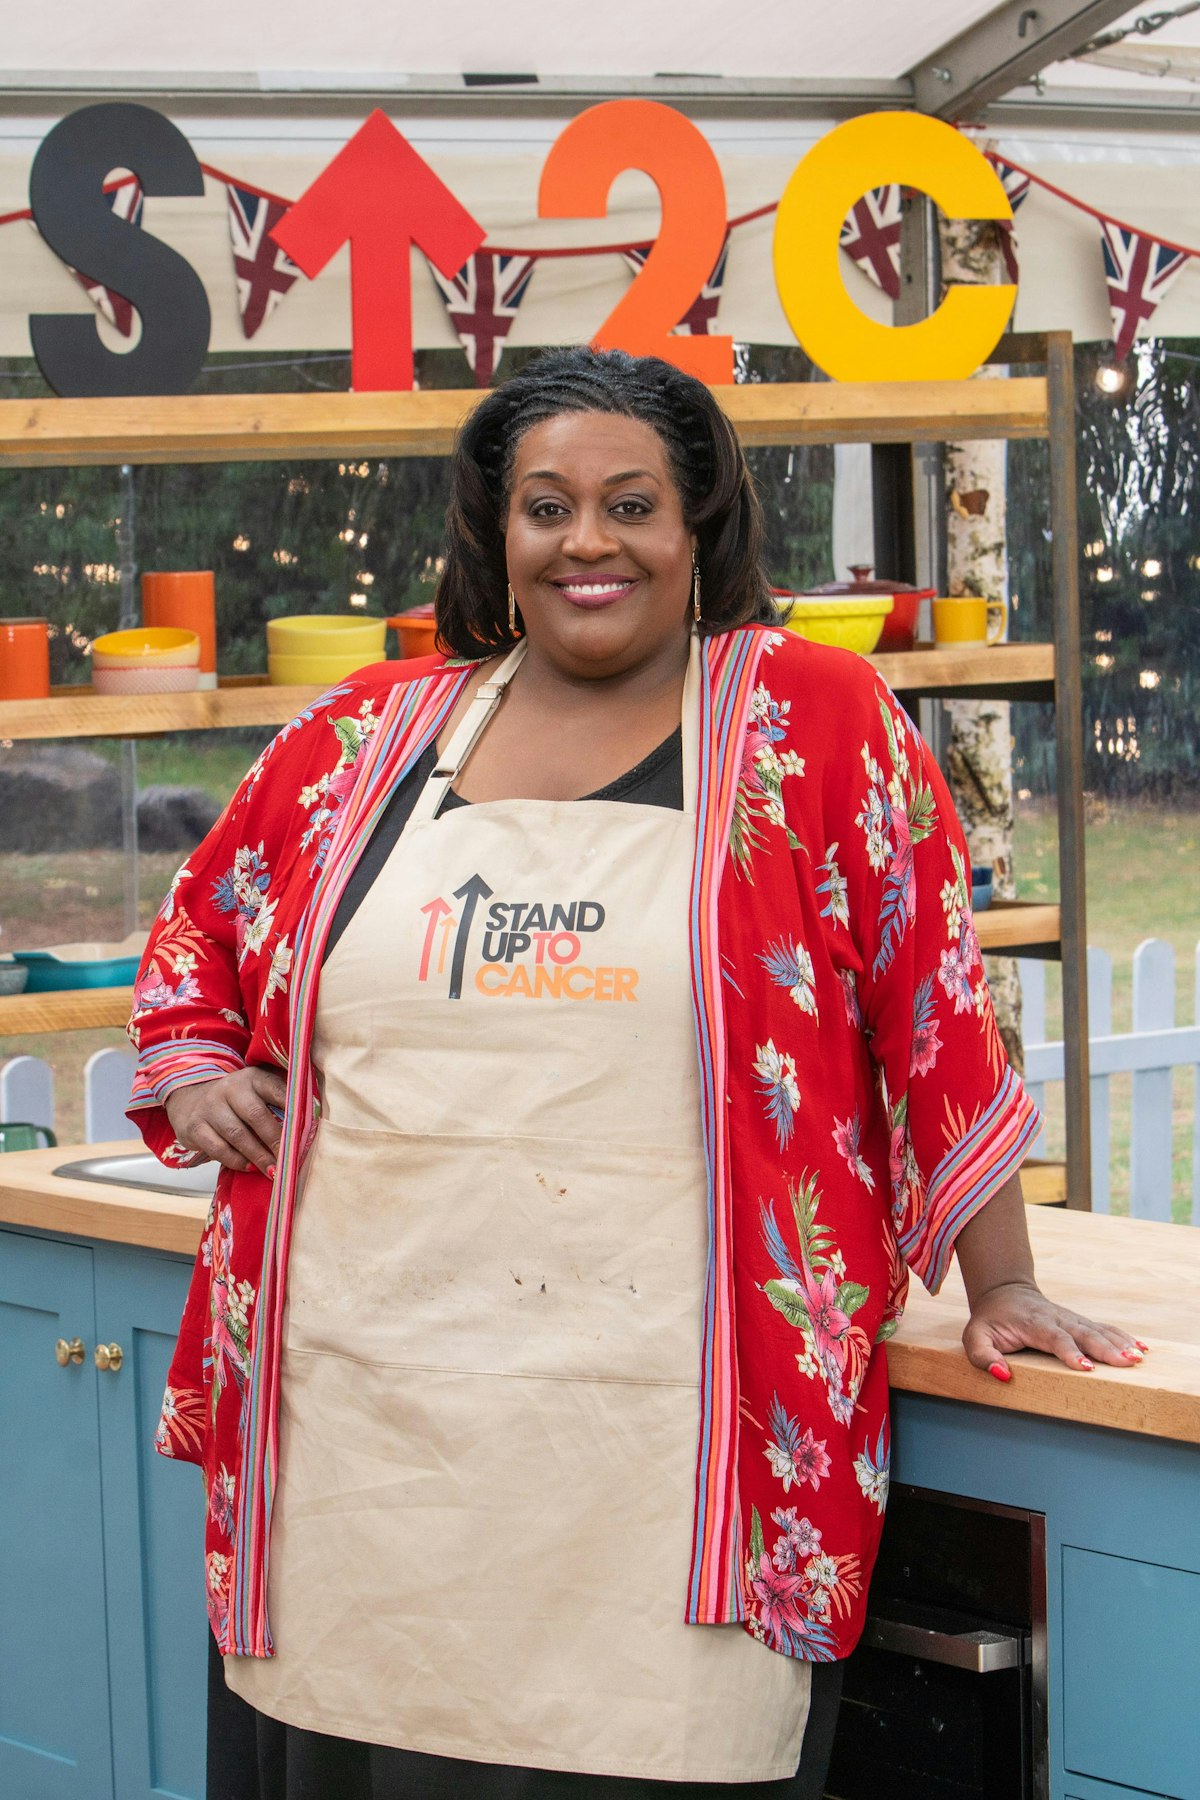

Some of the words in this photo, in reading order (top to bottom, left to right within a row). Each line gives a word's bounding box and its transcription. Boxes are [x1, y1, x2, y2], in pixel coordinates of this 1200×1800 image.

[29, 102, 211, 397] S
[485, 901, 606, 932] STAND
[474, 963, 639, 1002] CANCER
